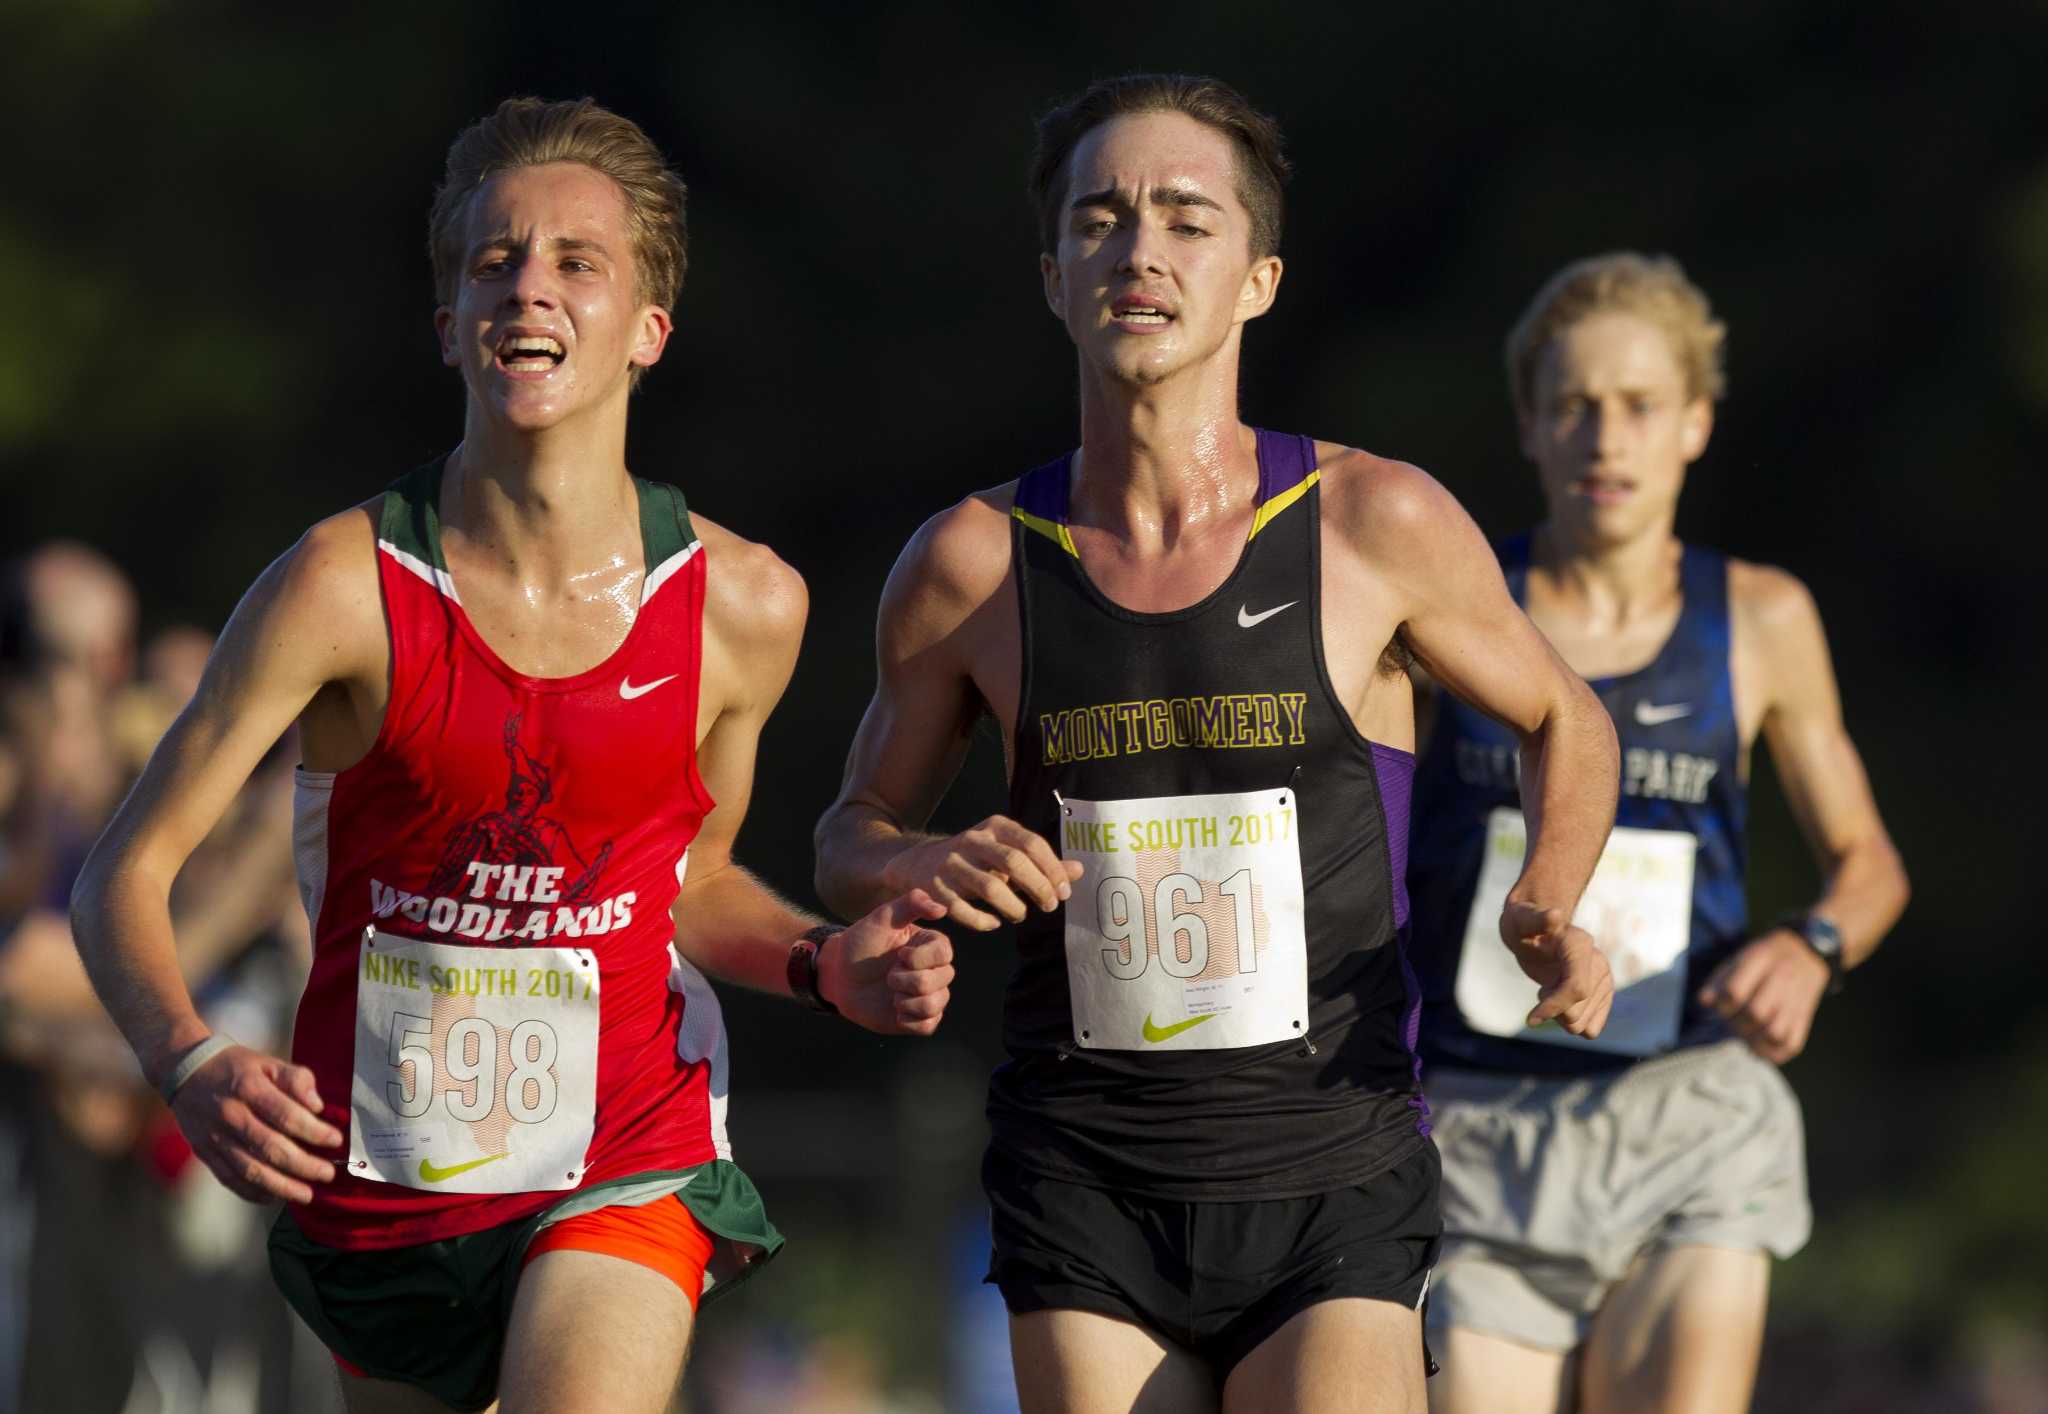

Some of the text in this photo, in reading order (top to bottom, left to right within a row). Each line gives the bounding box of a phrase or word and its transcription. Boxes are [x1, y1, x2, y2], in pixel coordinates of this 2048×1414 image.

[1040, 692, 1307, 766] MONTGOMERY
[1625, 748, 1718, 804] PARK
[1065, 808, 1293, 853] NIKE SOUTH 2017
[370, 878, 637, 942] WOODLANDS
[467, 861, 565, 903] THE
[1096, 868, 1257, 981] 961
[365, 951, 593, 1001] NIKE SOUTH 2017
[386, 1011, 558, 1125] 598
